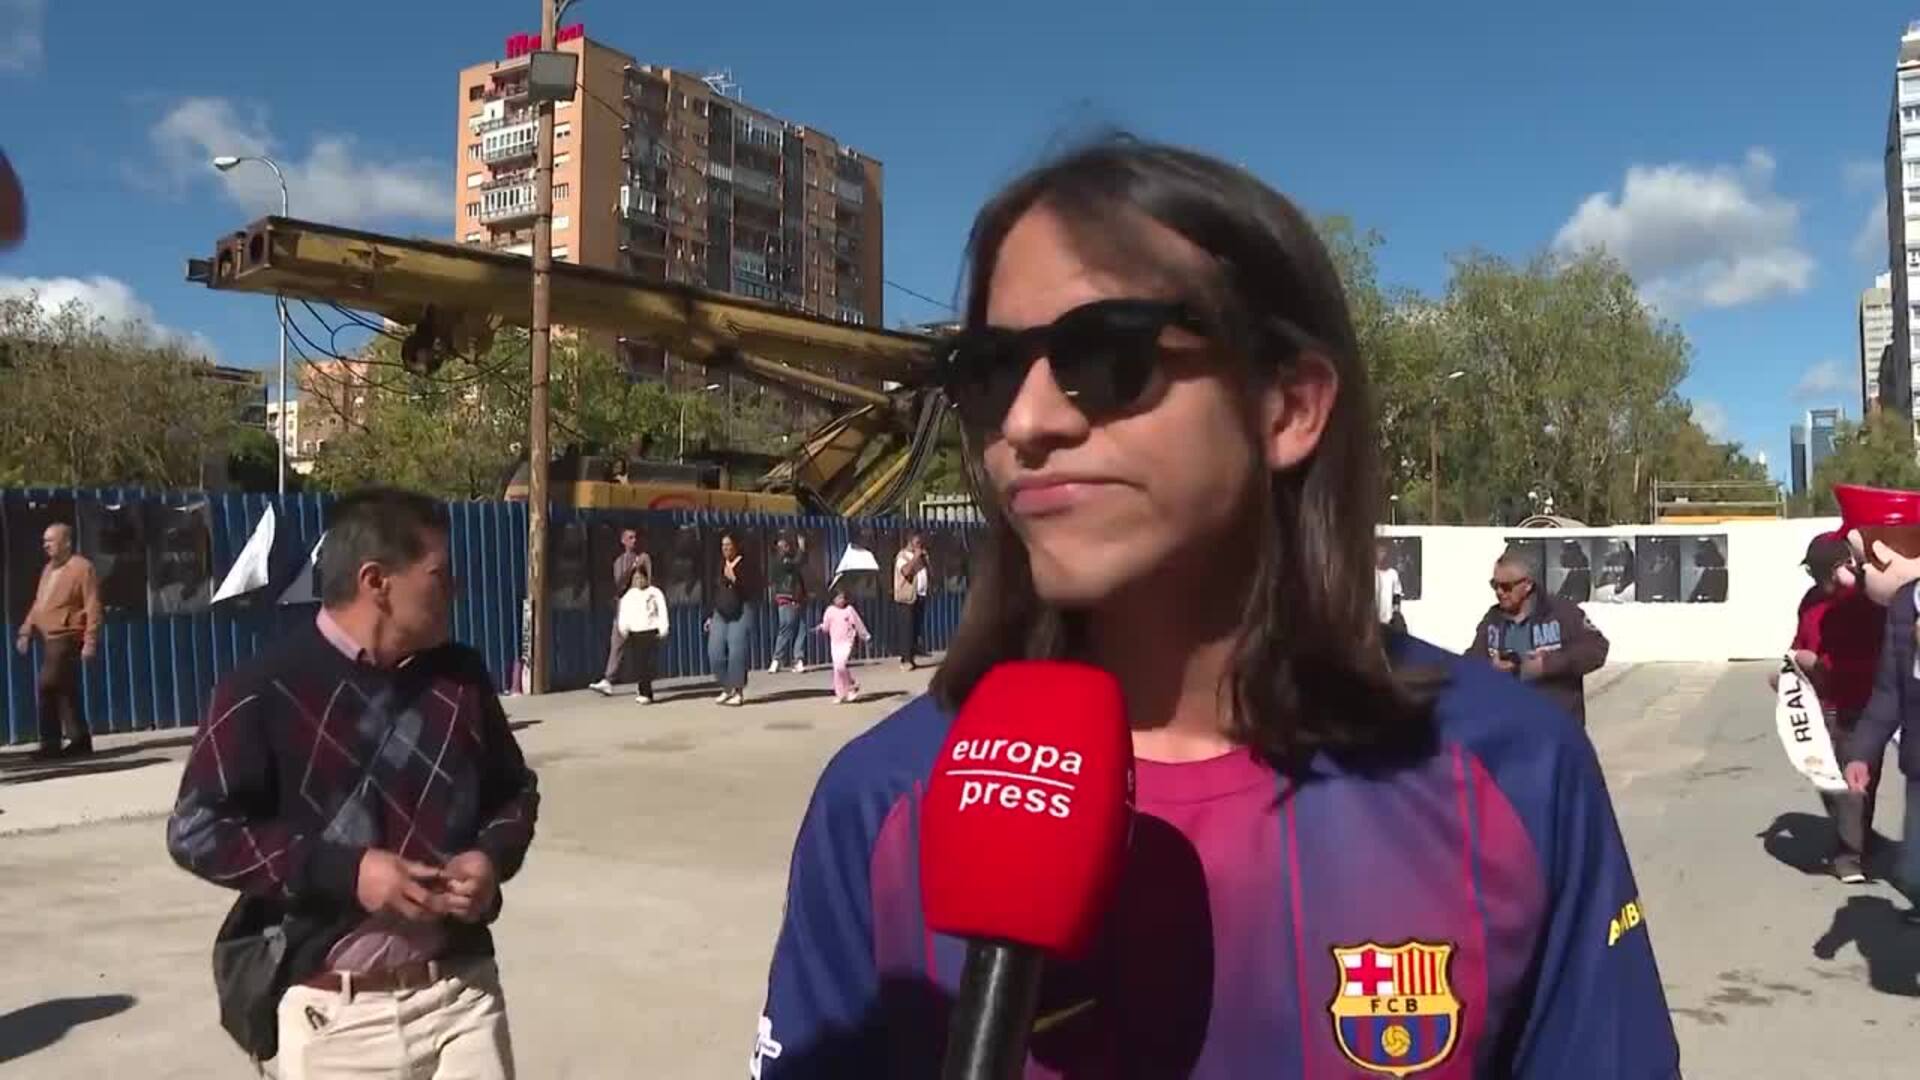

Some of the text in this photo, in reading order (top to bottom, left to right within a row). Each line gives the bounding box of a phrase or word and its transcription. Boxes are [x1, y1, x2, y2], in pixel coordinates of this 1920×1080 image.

[1784, 679, 1813, 743] REAL
[952, 738, 1083, 775] europa
[958, 780, 1072, 818] press
